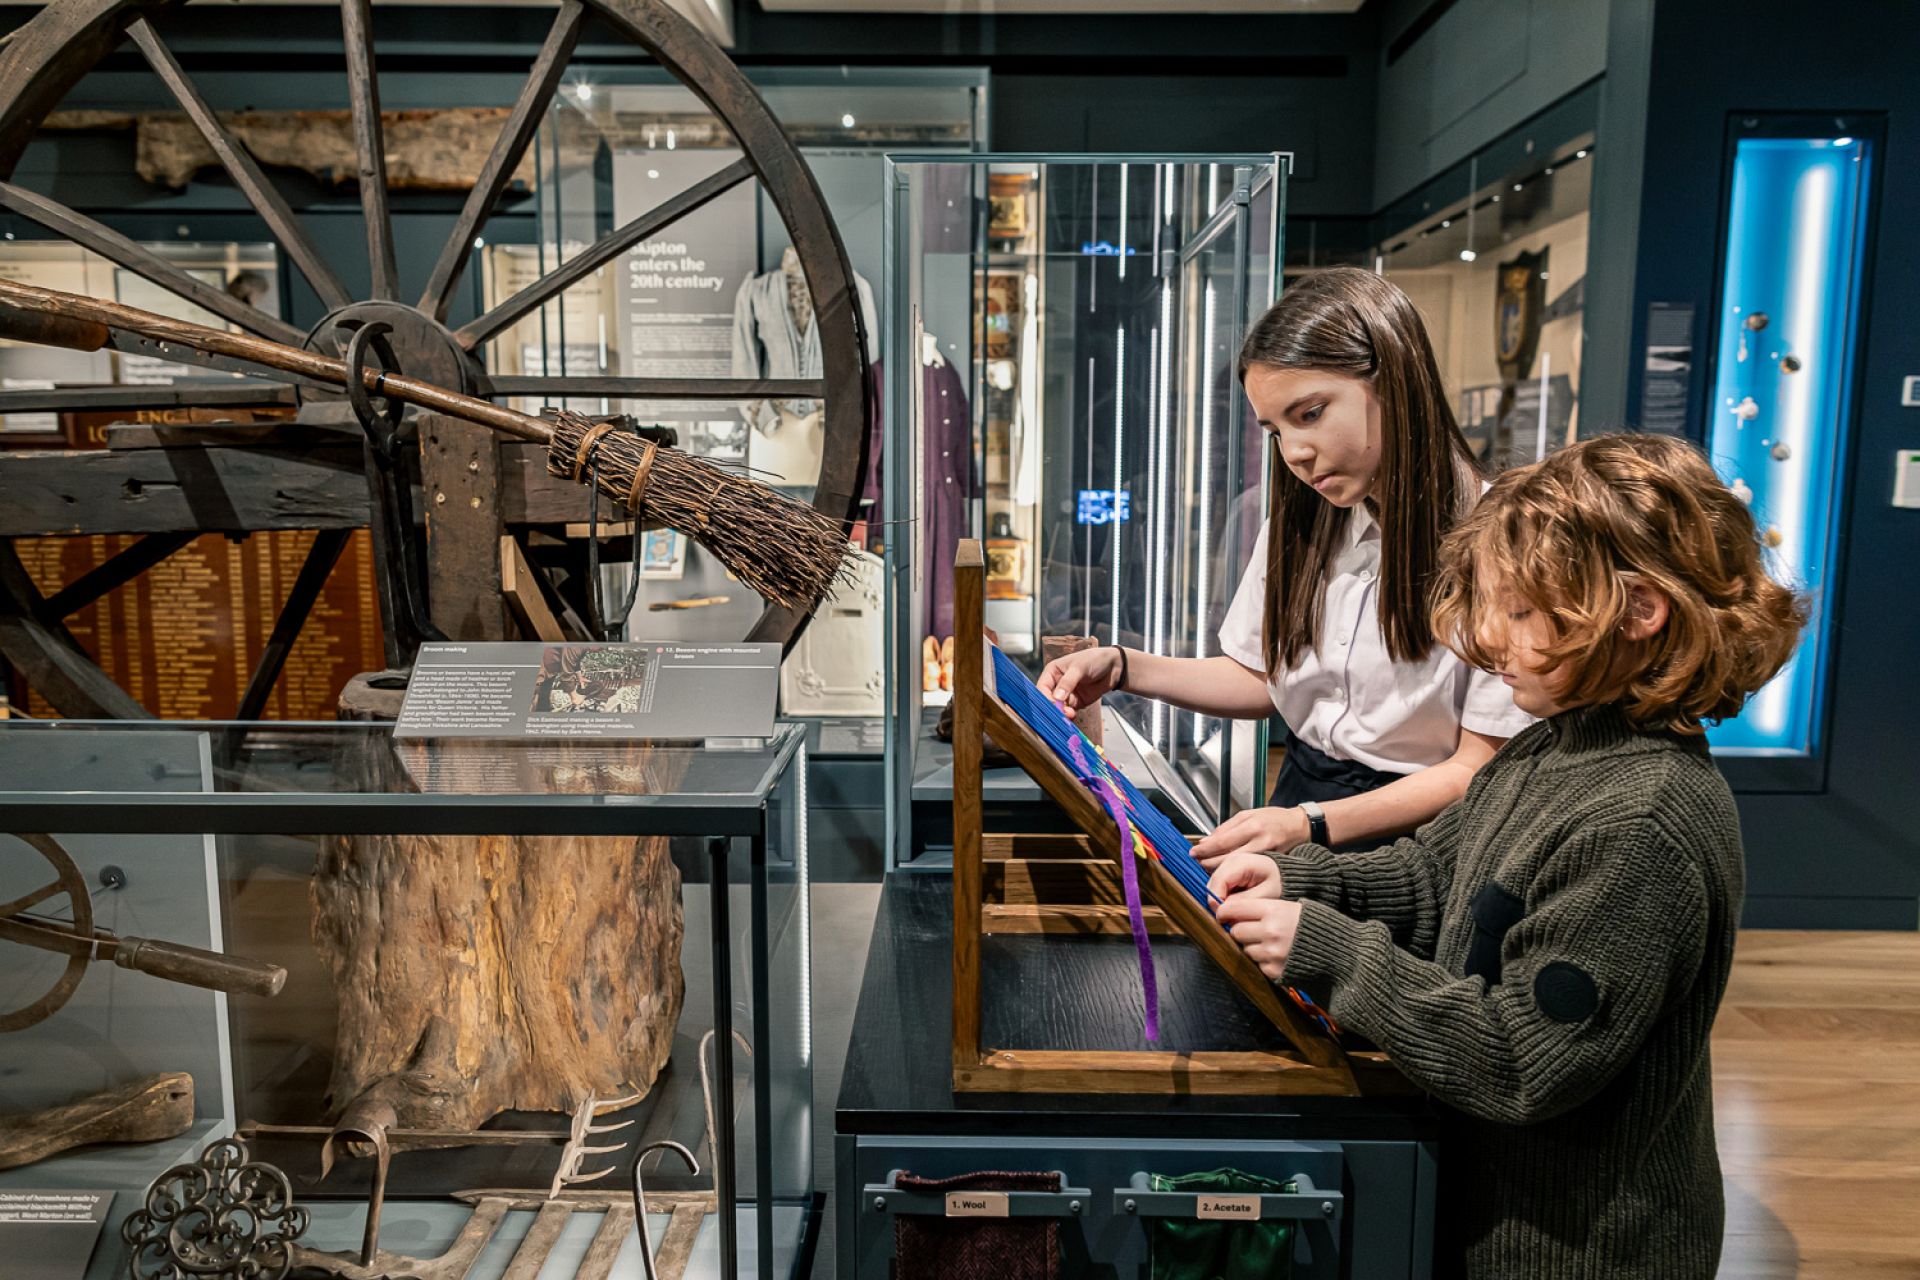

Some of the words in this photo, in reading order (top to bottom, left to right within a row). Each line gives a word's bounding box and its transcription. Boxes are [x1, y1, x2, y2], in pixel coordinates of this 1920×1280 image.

[630, 241, 686, 256] Skipton
[630, 259, 678, 272] enters
[681, 256, 705, 272] the
[630, 274, 663, 288] 20th
[665, 275, 723, 291] century
[952, 1201, 960, 1209] 1.
[962, 1201, 986, 1209] Wool
[1214, 1204, 1251, 1212] Acetate
